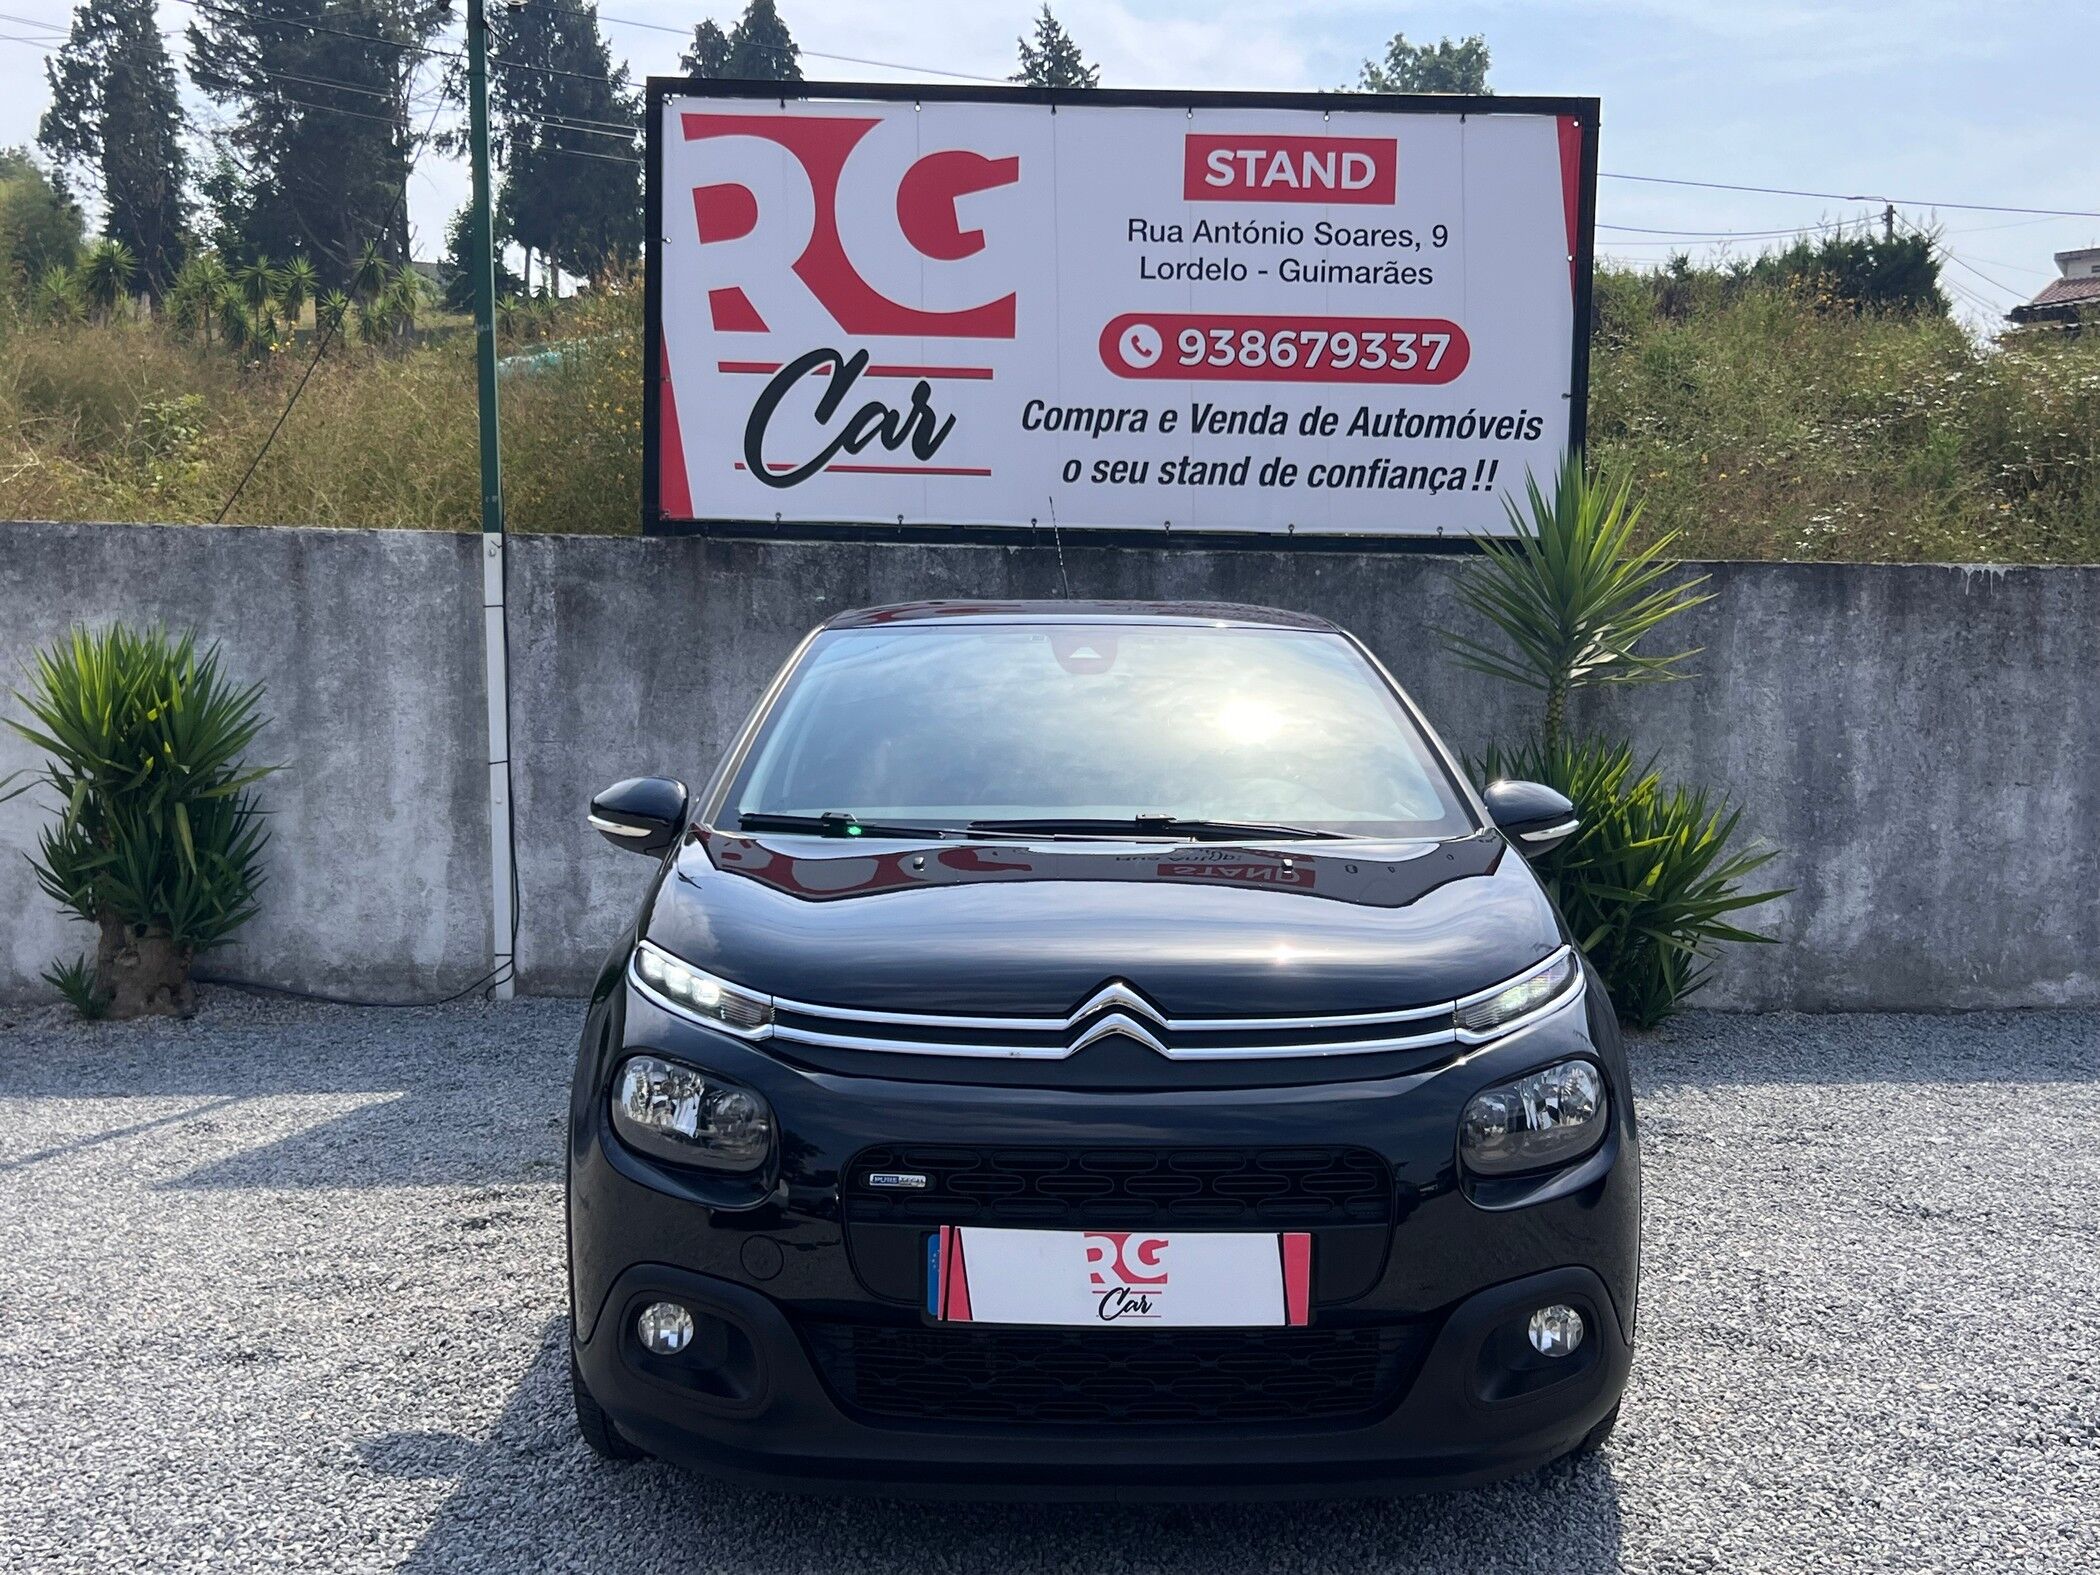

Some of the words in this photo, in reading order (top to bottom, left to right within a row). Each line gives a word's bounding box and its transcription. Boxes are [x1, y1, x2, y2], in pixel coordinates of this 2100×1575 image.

[1205, 150, 1376, 190] STAND
[681, 113, 1020, 339] RG
[1128, 218, 1184, 243] Rua
[1192, 219, 1304, 246] António
[1313, 221, 1421, 251] Soares,
[1432, 224, 1449, 249] 9
[1140, 255, 1248, 282] Lordelo
[1278, 257, 1434, 286] Guimarães
[1178, 328, 1451, 370] 938679337
[743, 347, 957, 489] Car
[1021, 399, 1149, 440] Compra
[1158, 409, 1179, 434] e
[1191, 402, 1289, 436] Venda
[1298, 405, 1340, 437] de
[1345, 405, 1544, 441] Automóveis
[1062, 459, 1082, 484] o
[1090, 459, 1150, 485] seu
[1157, 455, 1252, 487] stand
[1258, 456, 1299, 488] de
[1083, 1232, 1169, 1285] RG
[1098, 1286, 1153, 1321] Car
